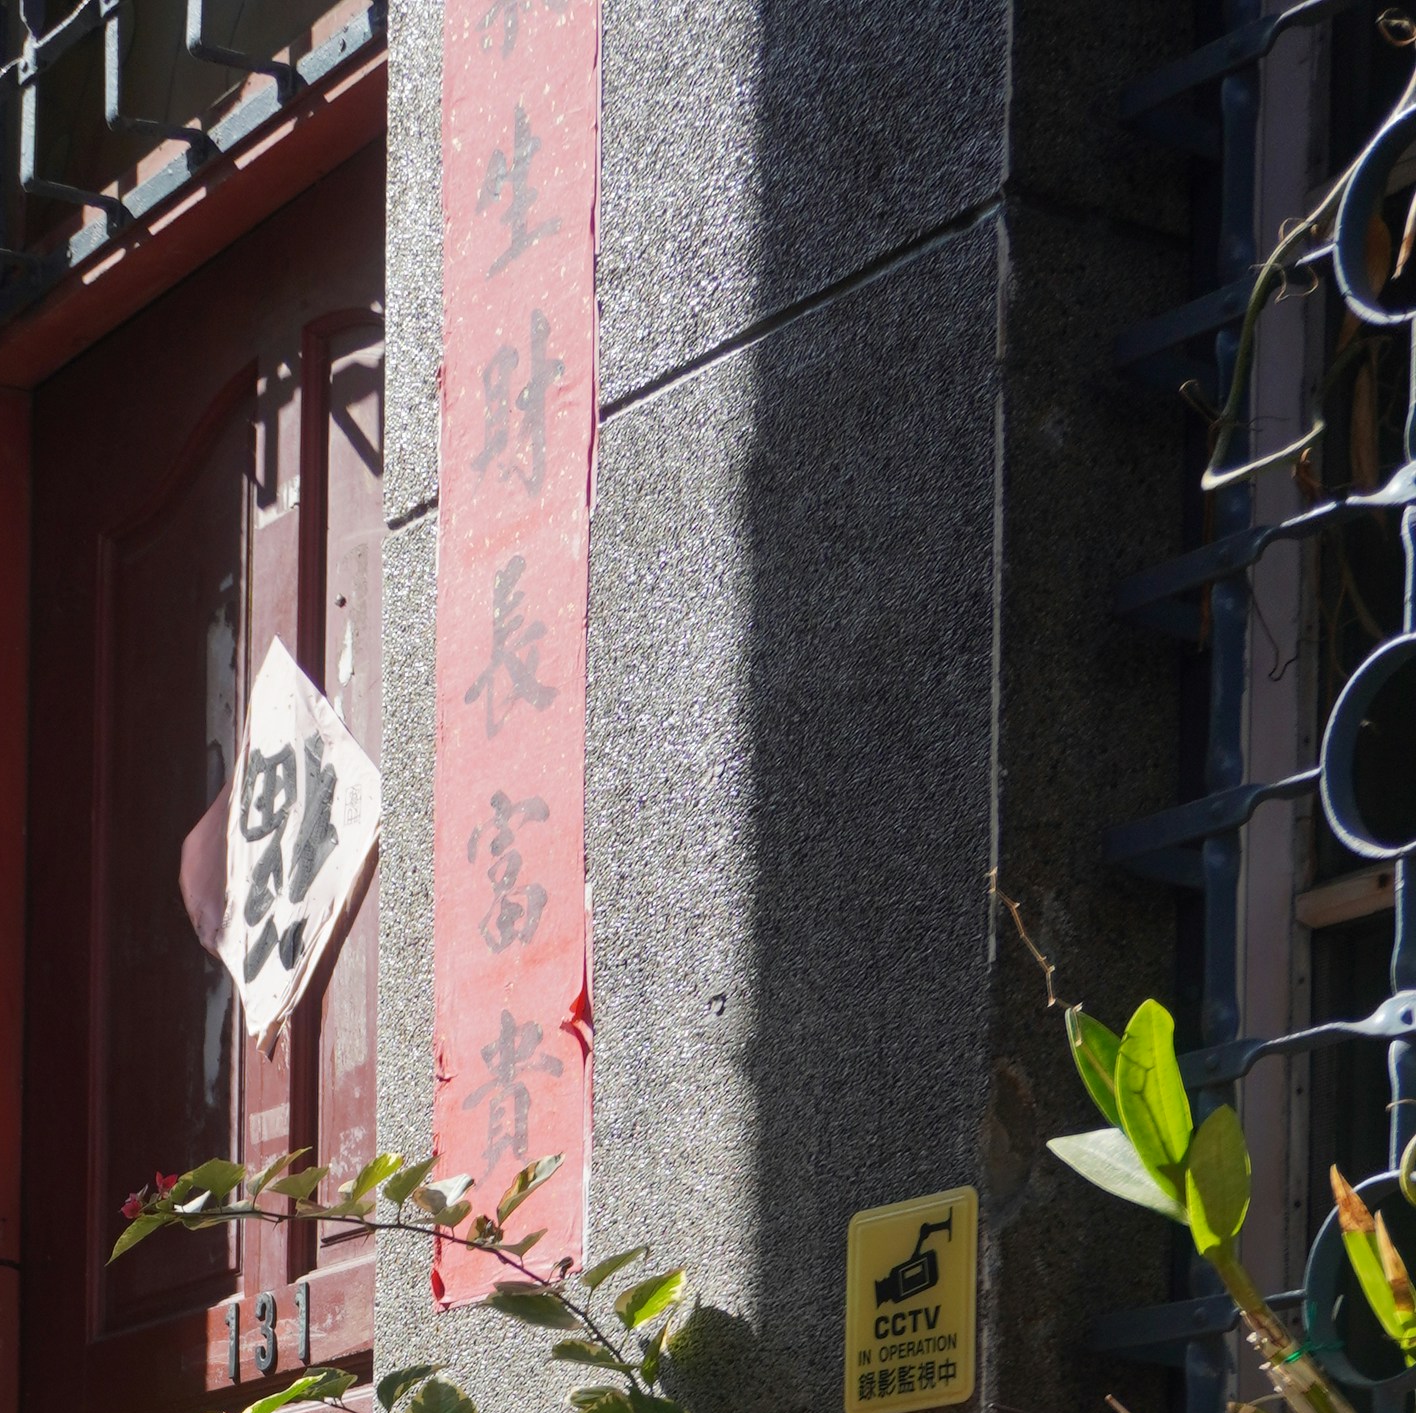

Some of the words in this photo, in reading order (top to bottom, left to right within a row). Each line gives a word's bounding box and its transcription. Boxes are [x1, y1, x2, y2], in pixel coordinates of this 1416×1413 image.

[240, 730, 339, 984] 福
[225, 1281, 310, 1380] 131
[874, 1305, 942, 1340] CCTV
[858, 1349, 871, 1367] IN
[879, 1333, 958, 1363] OPERATION
[857, 1359, 958, 1401] 錄影監視中
